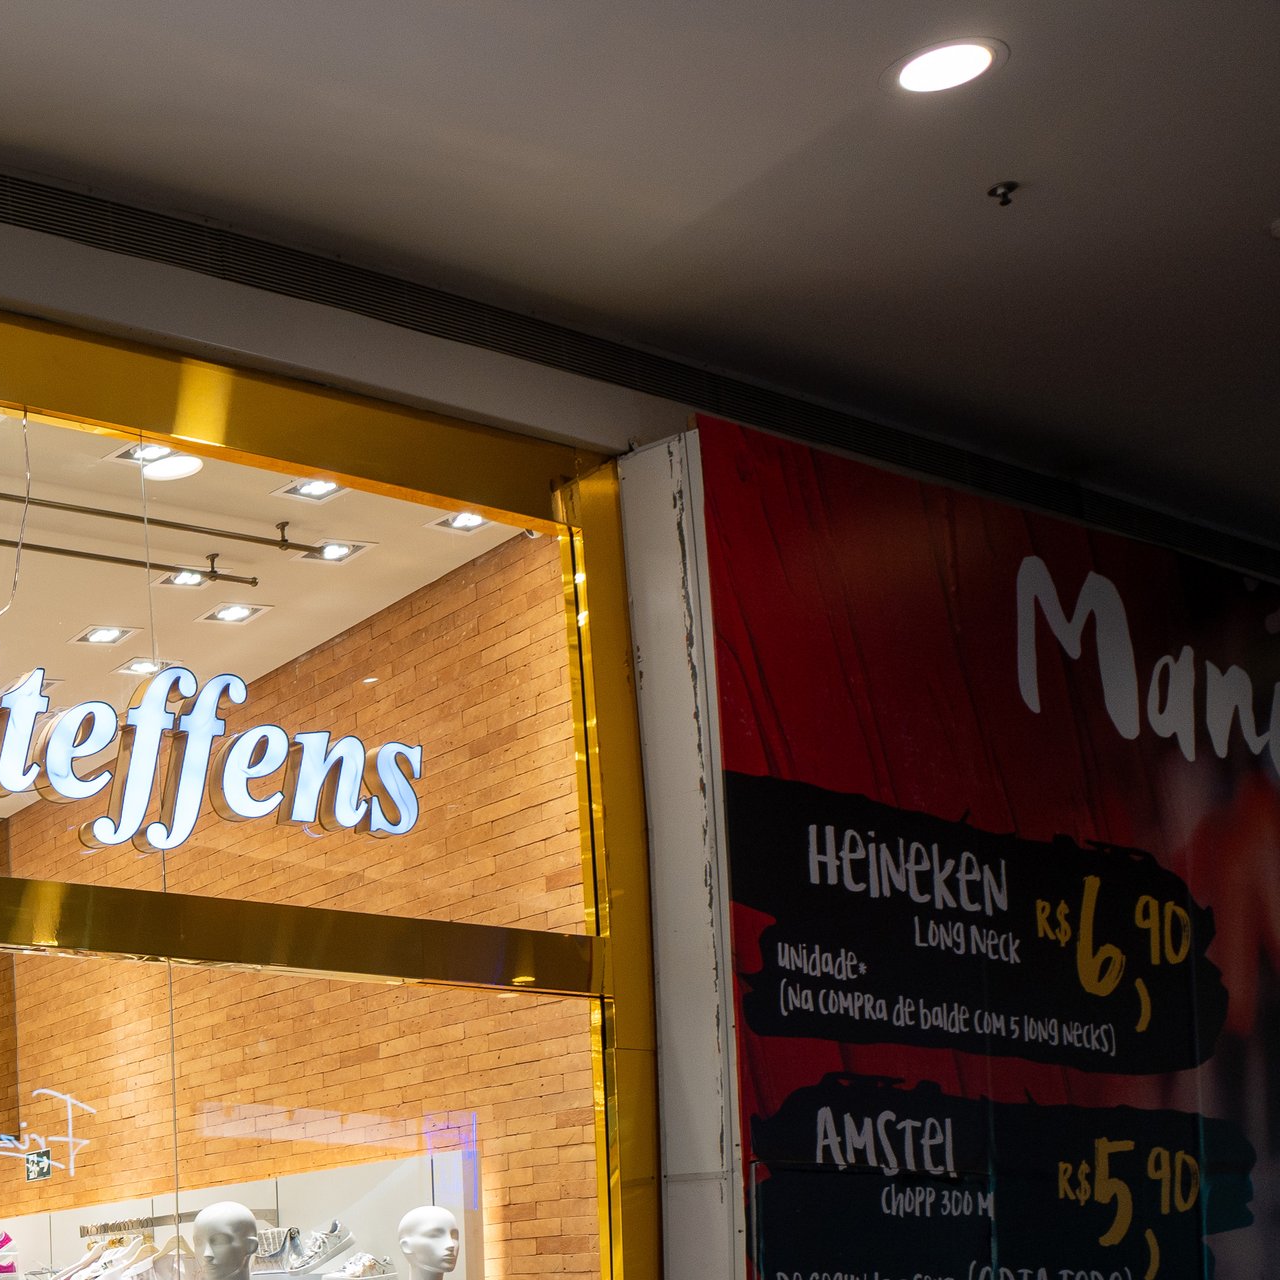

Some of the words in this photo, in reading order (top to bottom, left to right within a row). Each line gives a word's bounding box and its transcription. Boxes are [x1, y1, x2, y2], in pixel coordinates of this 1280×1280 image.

[1016, 554, 1280, 784] Man
[1036, 898, 1072, 947] R$
[893, 995, 915, 1026] de
[1010, 1016, 1020, 1037] 5
[941, 1190, 973, 1216] 300
[1057, 1161, 1091, 1206] R$
